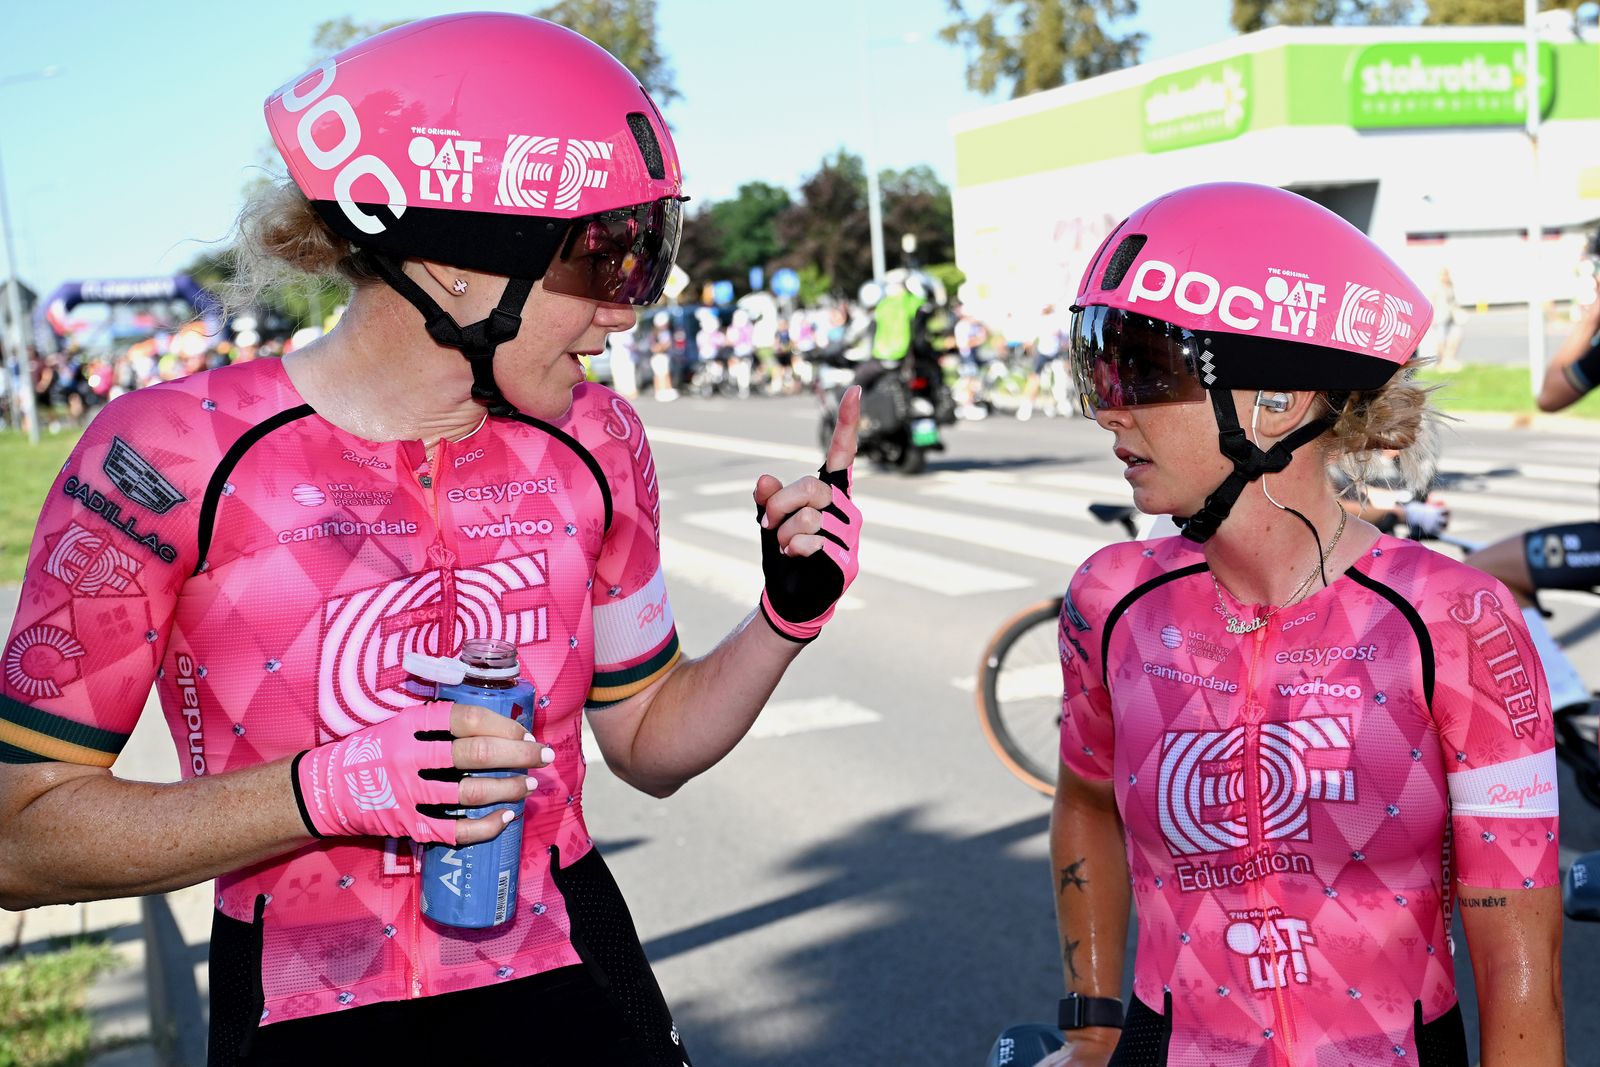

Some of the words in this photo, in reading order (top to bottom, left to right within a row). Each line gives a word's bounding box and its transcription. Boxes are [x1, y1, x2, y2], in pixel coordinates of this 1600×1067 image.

[1361, 54, 1511, 95] stokrotka
[411, 126, 427, 135] THE
[428, 127, 462, 137] ORIGINAL
[419, 169, 474, 204] LY!
[494, 134, 614, 212] EF
[1268, 267, 1281, 275] THE
[1271, 304, 1317, 338] LY!
[1330, 281, 1415, 355] EF
[341, 449, 391, 470] Rapha
[327, 483, 354, 492] UCI
[331, 491, 394, 500] WOMEN'S
[447, 476, 558, 504] easypost
[334, 498, 393, 507] PROTEAM
[62, 475, 178, 564] CADILLAC
[277, 518, 418, 545] cannondale
[460, 514, 555, 540] wahoo
[1187, 630, 1207, 641] UCI
[1187, 639, 1231, 656] WOMEN'S
[1185, 647, 1227, 663] PROTEAM
[1275, 642, 1378, 667] easypost
[1450, 588, 1540, 739] STIFEL
[1142, 662, 1239, 694] cannondale
[1276, 676, 1363, 701] wahoo
[177, 654, 206, 776] ondale
[1158, 714, 1359, 857] EF
[1487, 773, 1553, 809] Rapha
[1177, 848, 1313, 892] Education
[1229, 911, 1248, 920] THE
[1247, 951, 1308, 991] LY!
